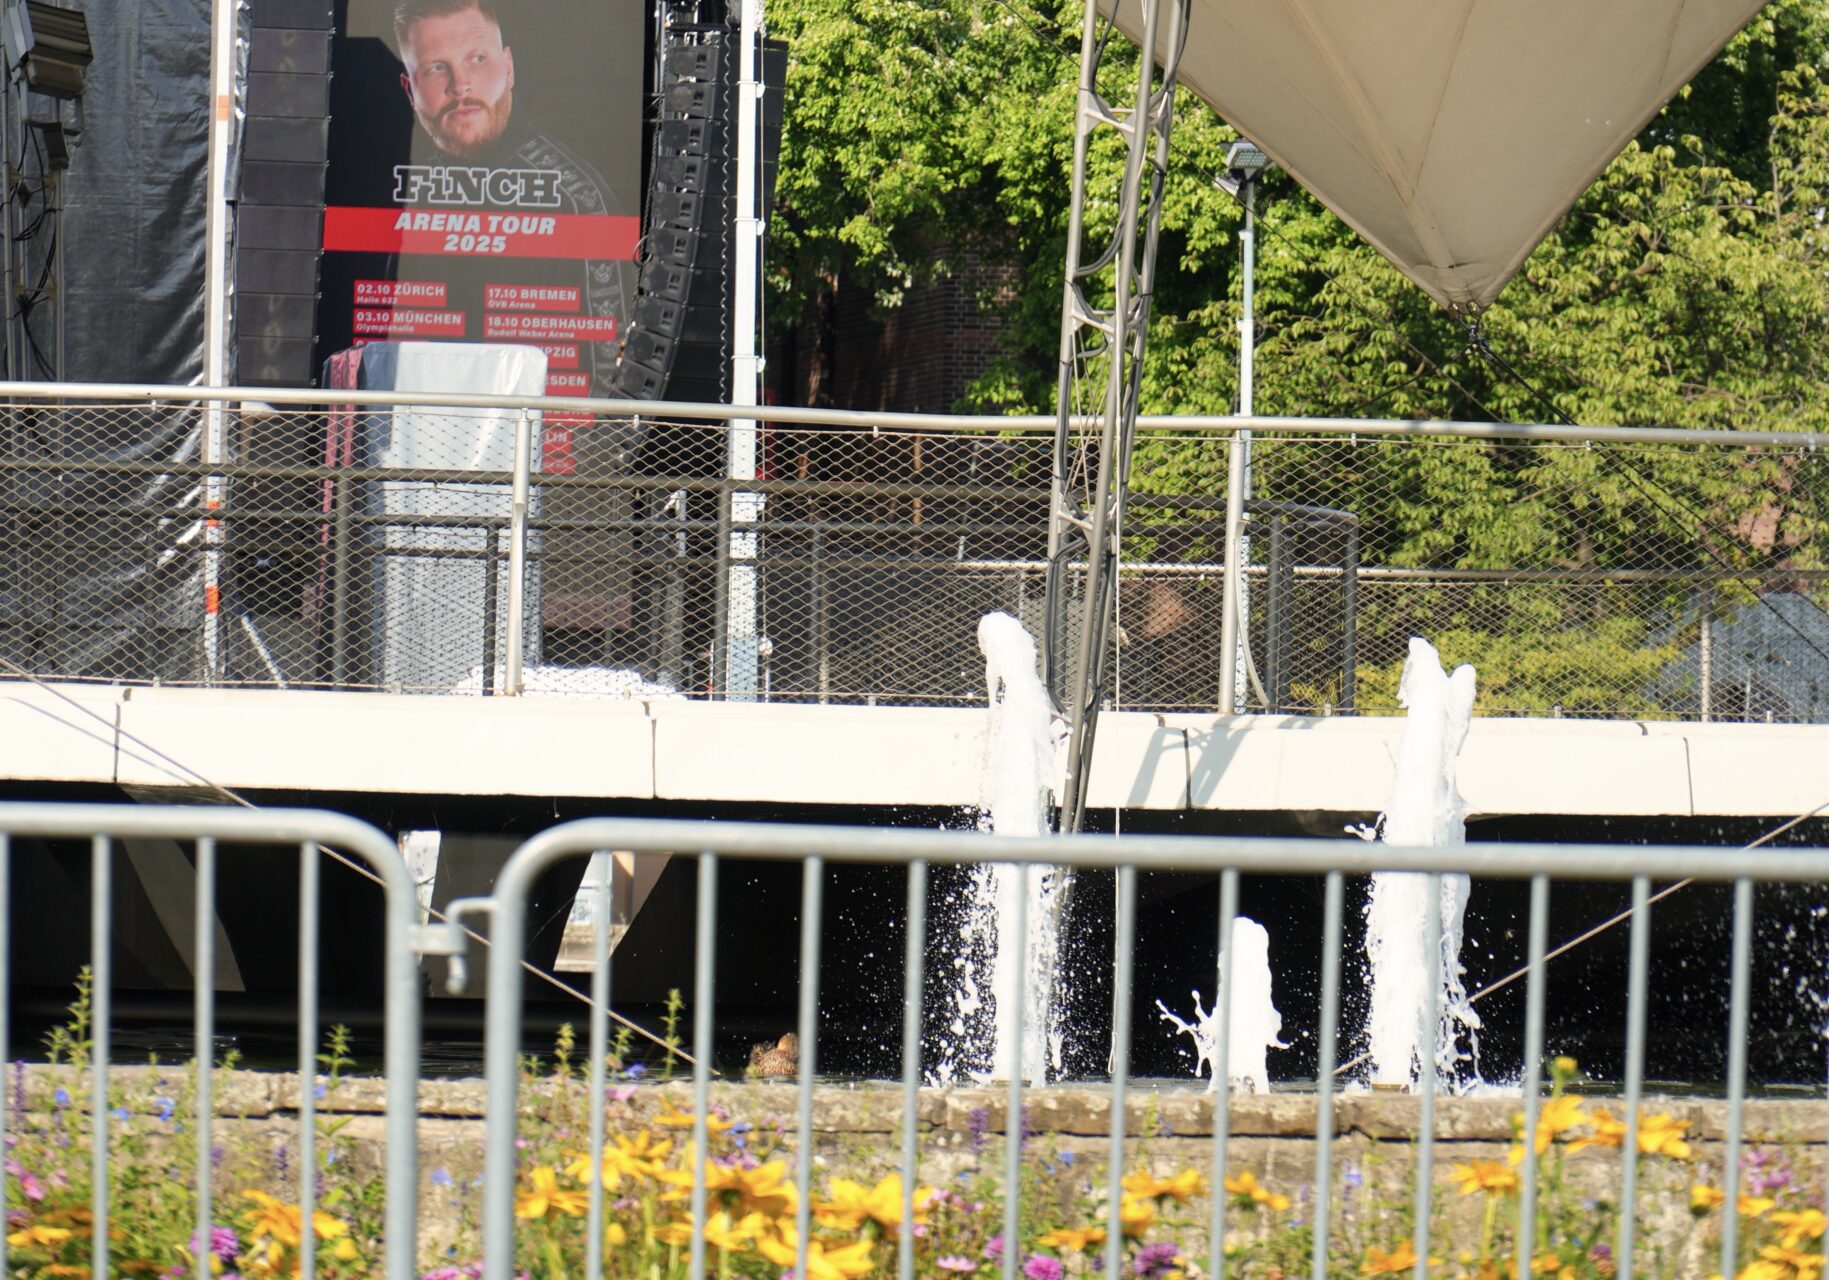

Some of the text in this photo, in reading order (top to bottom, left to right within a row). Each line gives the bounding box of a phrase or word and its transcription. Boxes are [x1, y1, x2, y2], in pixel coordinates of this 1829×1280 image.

[394, 212, 556, 236] ARENA TOUR
[443, 234, 507, 253] 2025
[357, 282, 445, 296] 02.10 ZÜRICH
[488, 288, 517, 299] 17.10
[521, 289, 577, 301] BREMEN
[357, 296, 380, 304] Halle
[509, 300, 536, 309] Arena
[357, 310, 462, 325] 03.10 MÜNCHEN
[488, 317, 613, 330] 18.10 OBERHAUSEN
[356, 322, 415, 333] Olympiahalle
[518, 329, 547, 338] Weber
[548, 330, 575, 339] Arena
